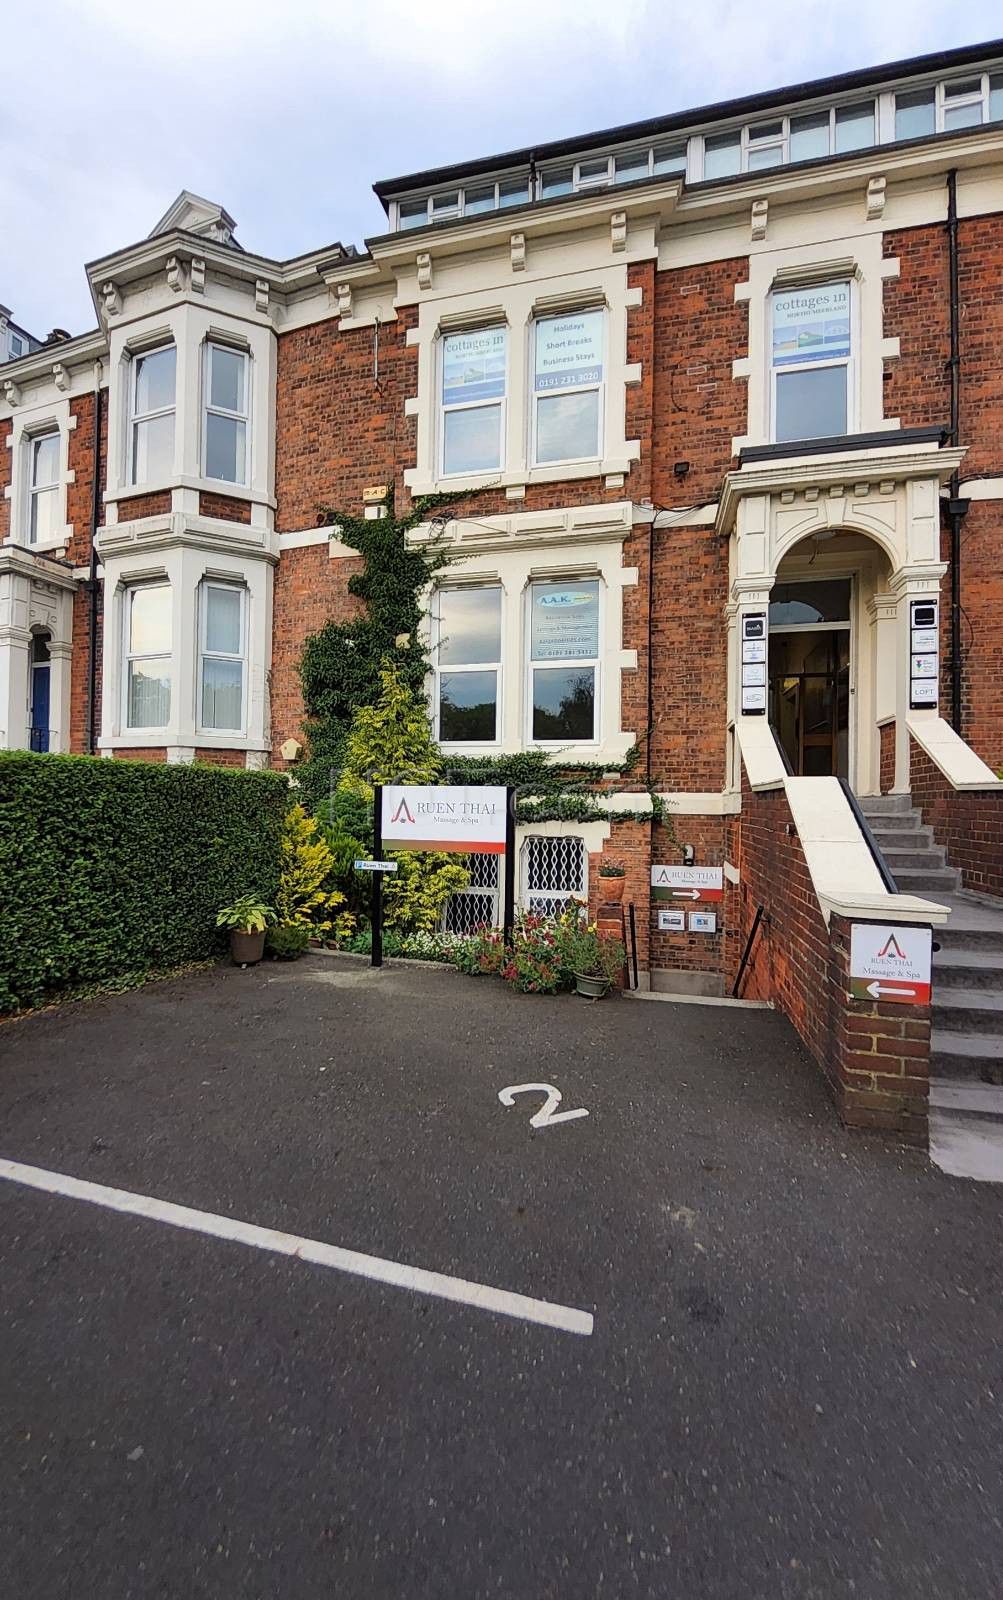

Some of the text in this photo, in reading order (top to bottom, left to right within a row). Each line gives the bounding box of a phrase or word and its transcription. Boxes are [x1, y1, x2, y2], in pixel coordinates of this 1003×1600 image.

[775, 293, 846, 312] cottages in
[553, 323, 585, 333] Holidays
[446, 337, 490, 353] cottages
[493, 335, 505, 345] in
[546, 337, 593, 350] Short Breaks
[543, 353, 595, 367] Business Stays
[539, 371, 599, 388] 0191 231 3020
[914, 687, 934, 696] LOFT
[417, 801, 497, 815] RUEN THAI
[433, 815, 479, 825] Massage & Spa
[672, 871, 718, 880] RUEN THAI
[893, 959, 913, 967] THAI
[863, 968, 896, 977] Massage
[906, 970, 921, 980] Spa
[498, 1083, 590, 1128] 2
